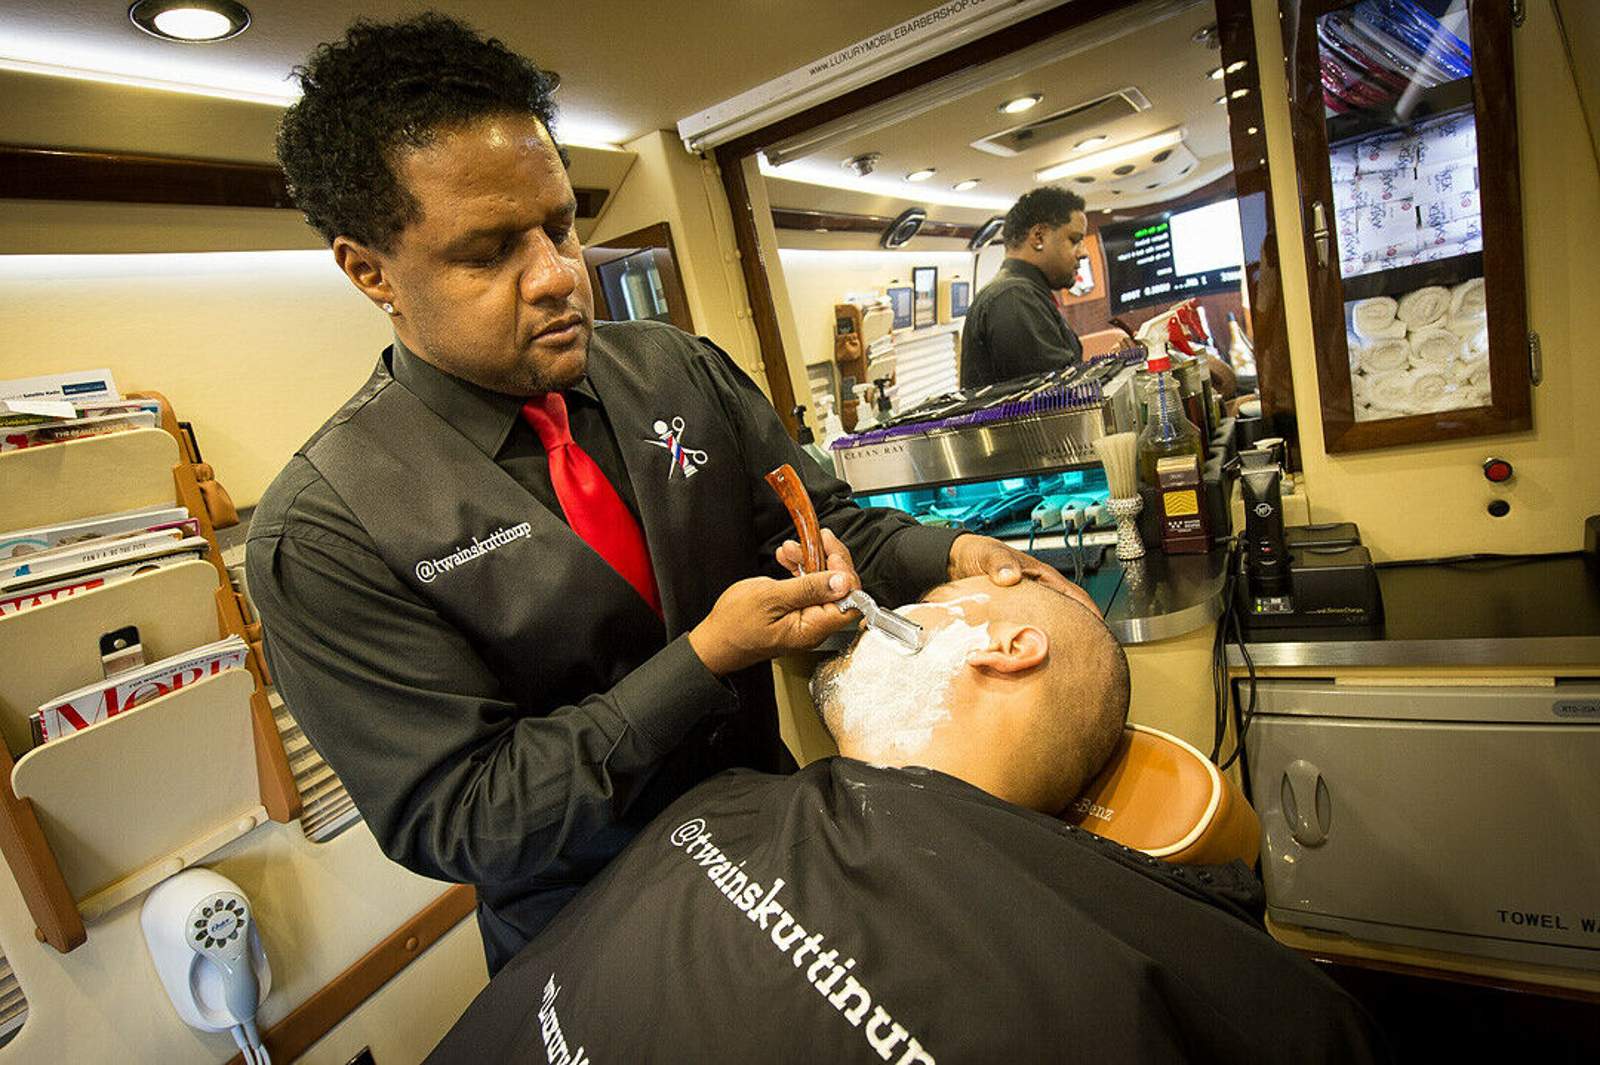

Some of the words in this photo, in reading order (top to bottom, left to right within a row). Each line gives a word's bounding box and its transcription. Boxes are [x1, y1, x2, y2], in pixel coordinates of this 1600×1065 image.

[808, 0, 986, 76] www.LUXURYMOBILEBARBERSHOP.C
[415, 522, 532, 583] @twainskuttinup
[1497, 909, 1569, 931] TOWEL
[1581, 917, 1600, 933] W
